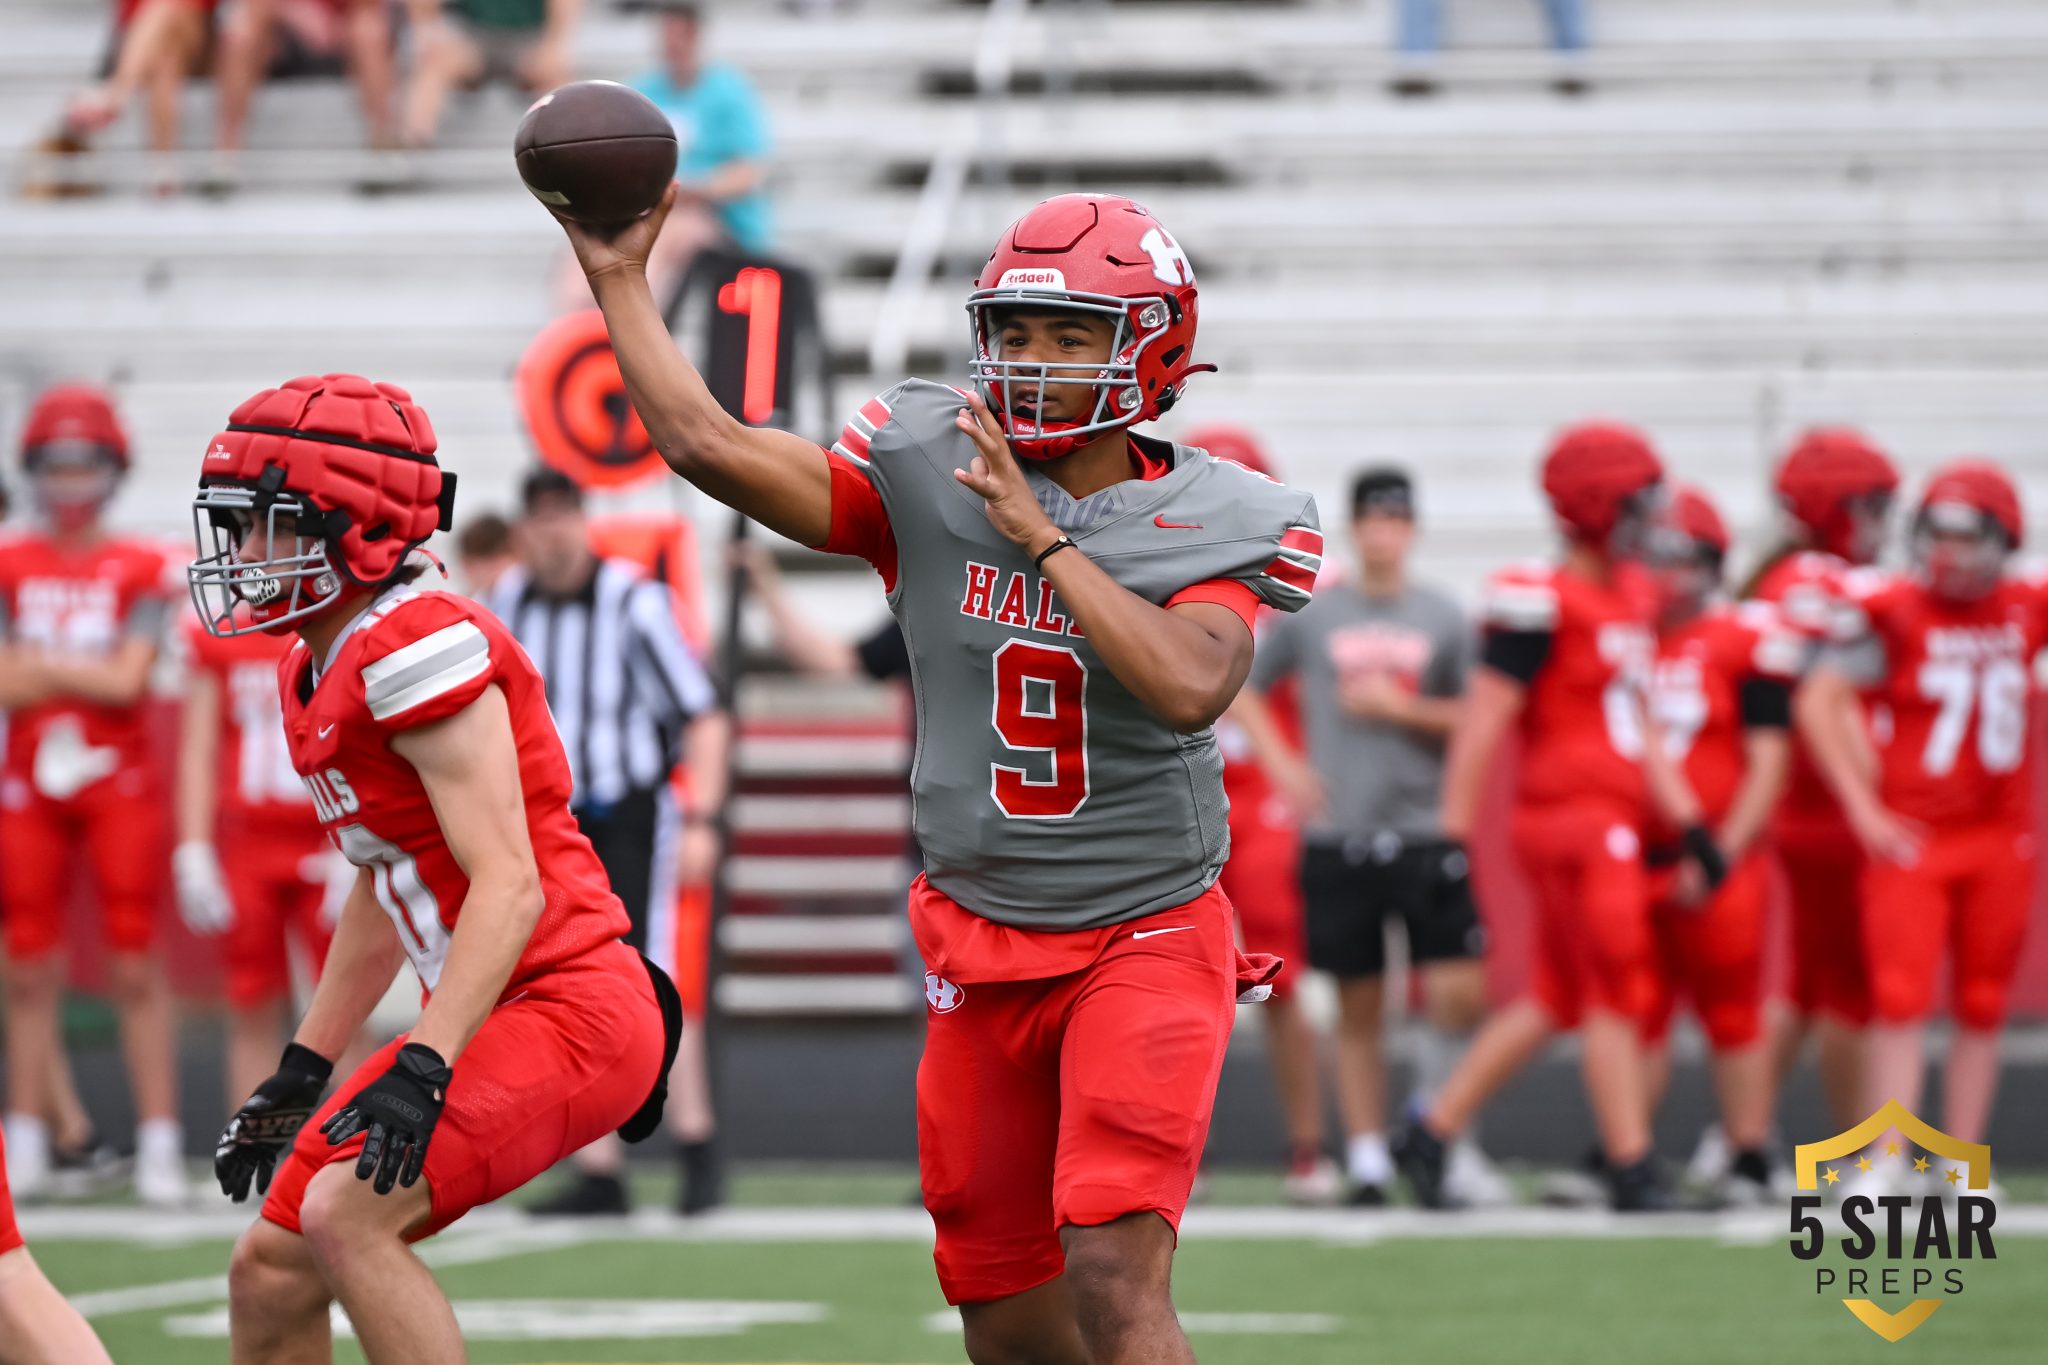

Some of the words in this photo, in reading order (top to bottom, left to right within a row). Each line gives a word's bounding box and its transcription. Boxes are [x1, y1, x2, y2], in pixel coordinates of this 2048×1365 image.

[1139, 227, 1195, 286] H
[718, 266, 781, 424] 1
[990, 637, 1090, 819] 9
[925, 975, 957, 1008] H
